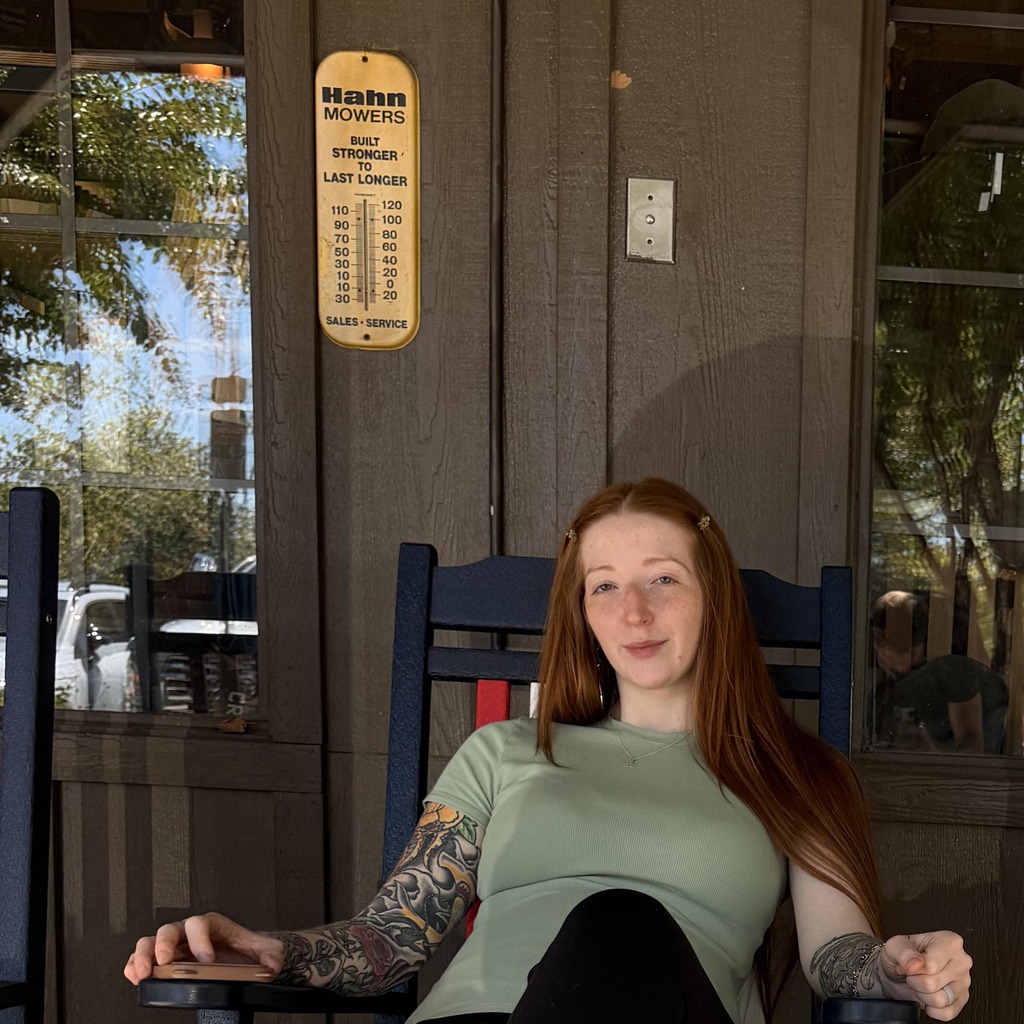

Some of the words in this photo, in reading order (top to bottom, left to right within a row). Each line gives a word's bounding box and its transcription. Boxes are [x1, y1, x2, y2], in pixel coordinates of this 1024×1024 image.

[322, 87, 406, 107] Hahn
[324, 107, 405, 124] MOWERS
[350, 136, 380, 146] BUILT
[332, 148, 398, 161] STRONGER
[358, 162, 372, 171] TO
[323, 172, 354, 184] LAST
[358, 174, 407, 186] LONGER
[331, 205, 349, 215] 110
[382, 200, 402, 210] 120
[334, 220, 349, 230] 90
[382, 215, 402, 225] 100
[334, 234, 349, 244] 70
[382, 230, 397, 239] 80
[334, 247, 349, 257] 50
[382, 242, 397, 252] 60
[334, 259, 350, 269] 30
[382, 255, 397, 265] 40
[337, 271, 350, 281] 10
[383, 268, 398, 277] 20
[337, 282, 350, 292] 10
[386, 279, 394, 289] 0
[335, 294, 350, 304] 30
[383, 291, 398, 300] 20
[326, 316, 359, 326] SALES
[366, 319, 408, 329] SERVICE
